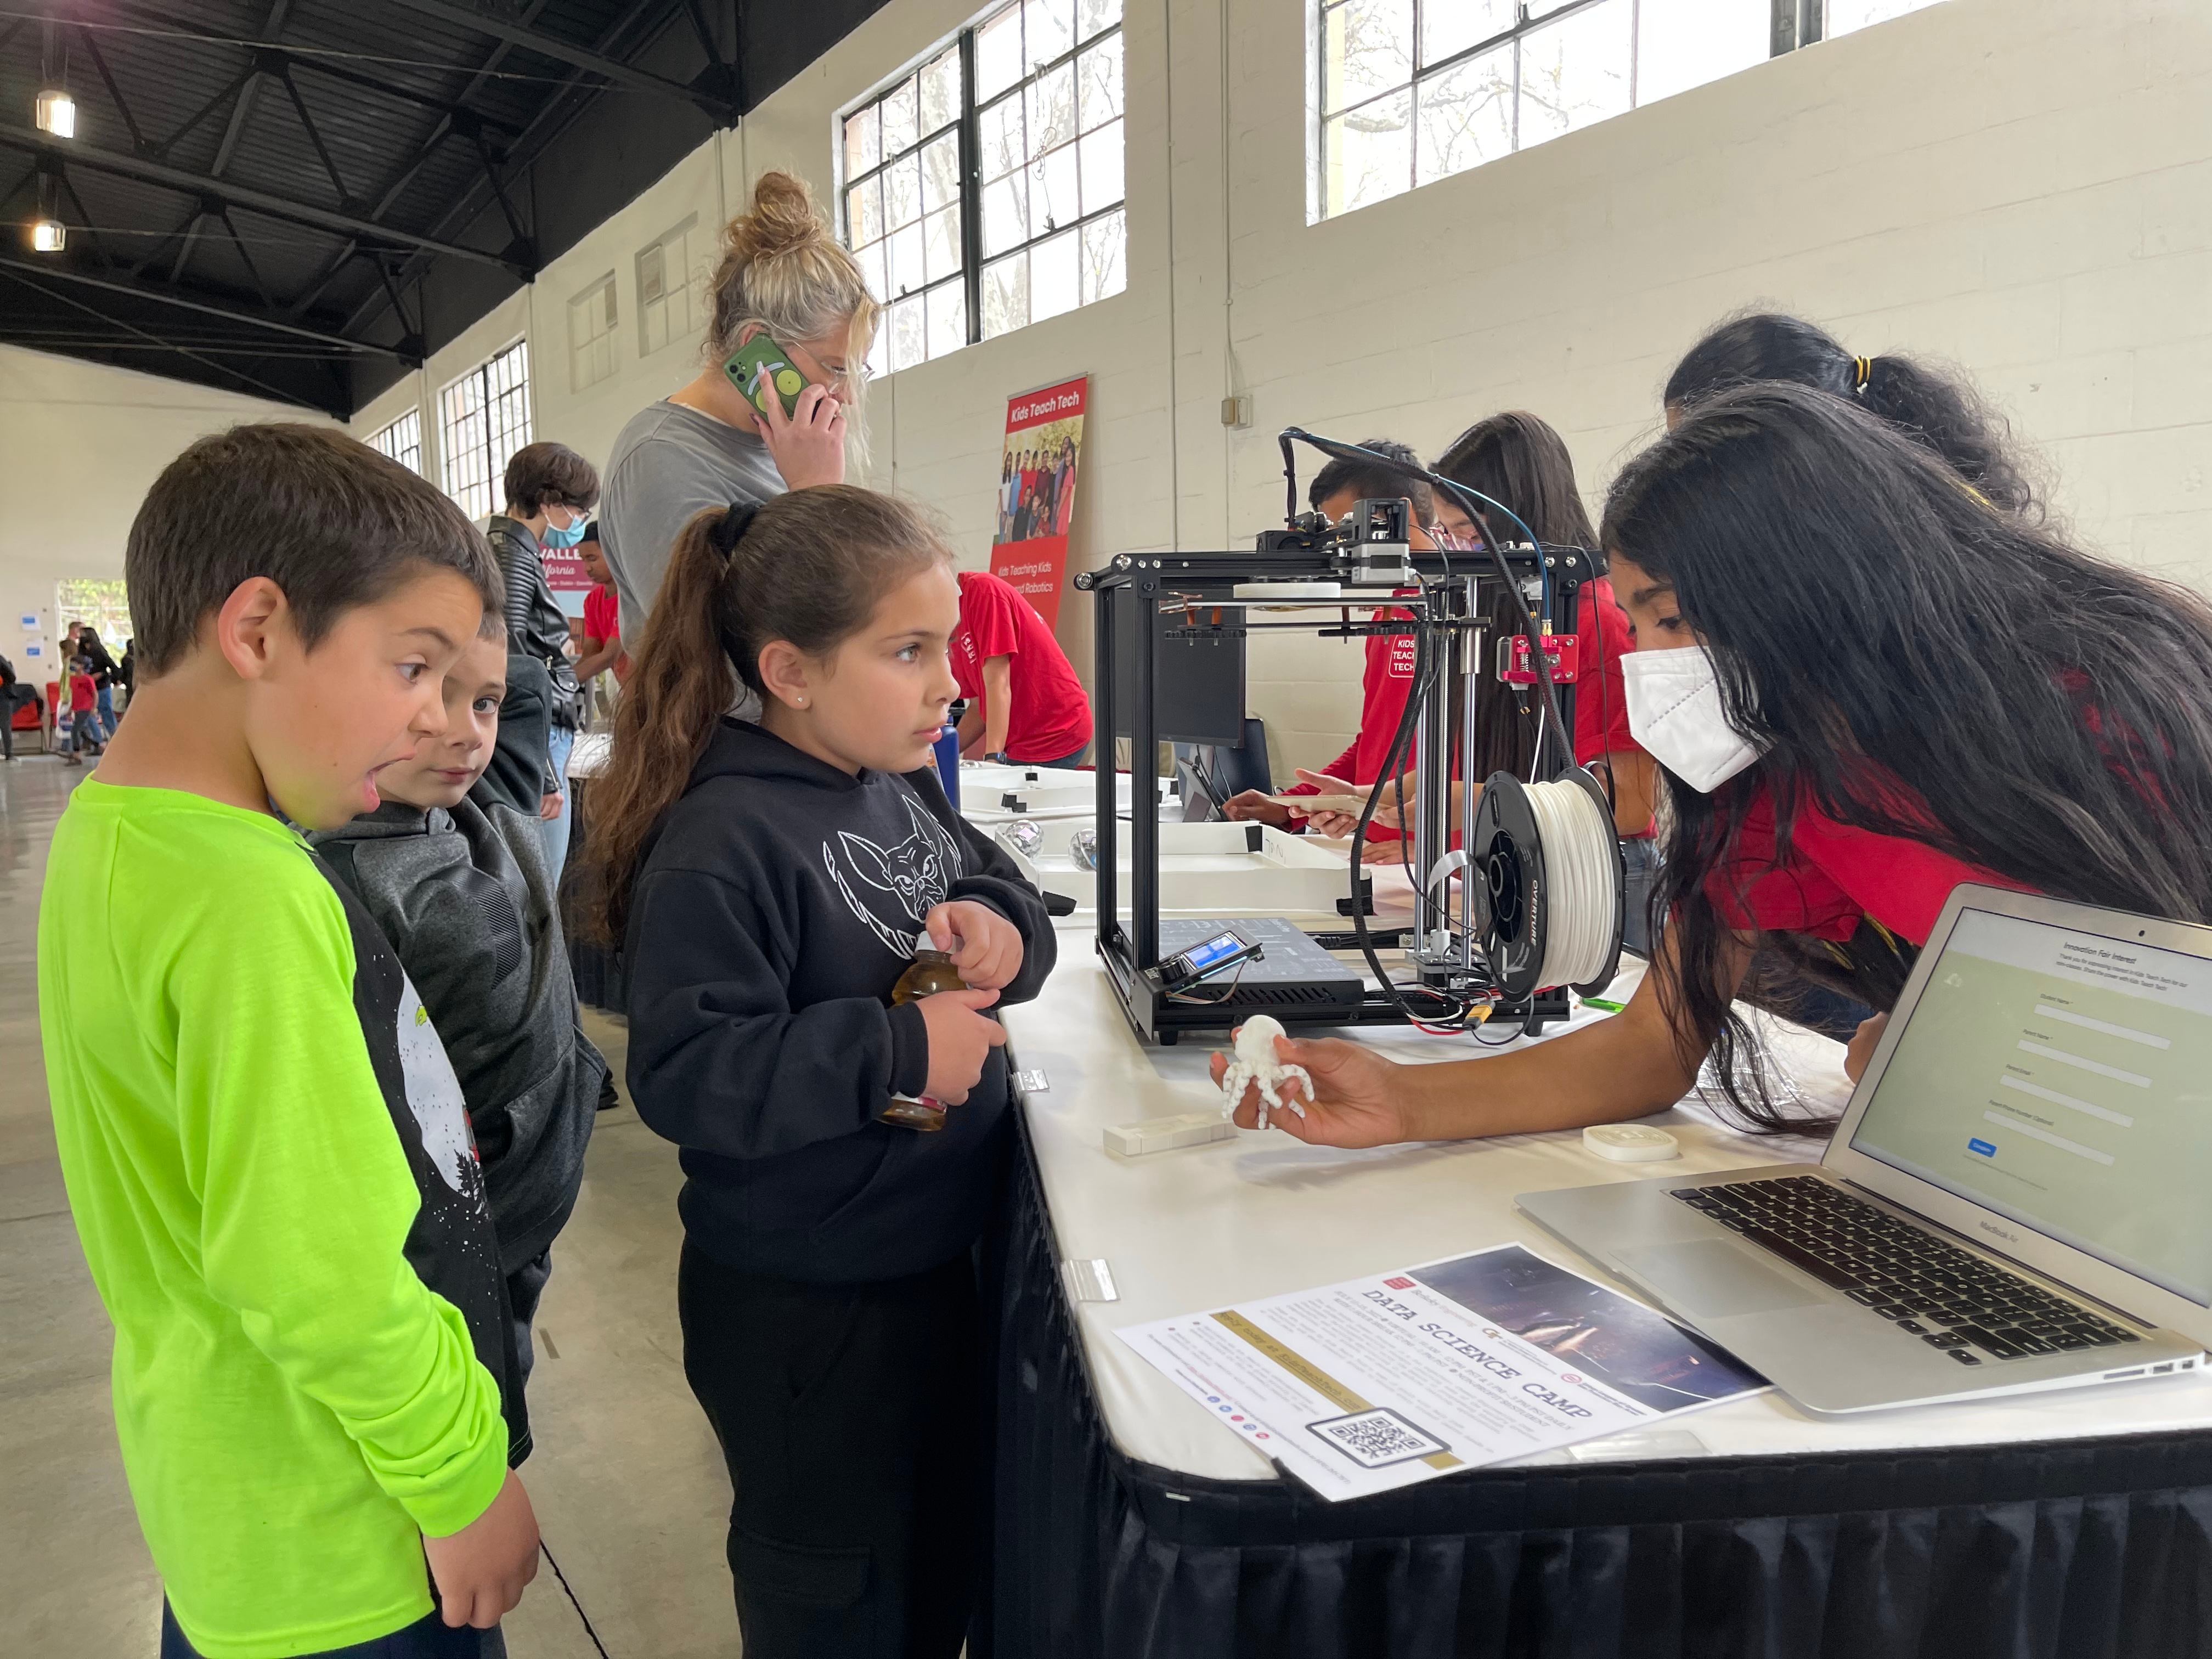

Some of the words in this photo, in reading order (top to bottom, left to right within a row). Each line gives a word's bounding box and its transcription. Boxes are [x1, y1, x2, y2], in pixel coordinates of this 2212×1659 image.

[1011, 406, 1029, 423] Kids
[1030, 398, 1056, 417] Teach
[1058, 391, 1080, 410] Tech
[539, 549, 583, 560] VALLE
[998, 567, 1008, 577] Kids
[1011, 562, 1037, 577] Teaching
[1038, 562, 1052, 573] Kids
[1015, 584, 1024, 594] nd
[1025, 582, 1053, 594] Robotics
[1398, 640, 1414, 648] KIDS
[2059, 953, 2072, 961] Thank
[2063, 942, 2097, 955] Innovation
[2098, 950, 2111, 958] Fair
[2112, 952, 2137, 964] Interest
[1980, 1221, 2008, 1239] MacBook
[1361, 1290, 1418, 1321] DATA
[1418, 1323, 1522, 1380] SCIENCE
[1522, 1383, 1593, 1419] CAMP
